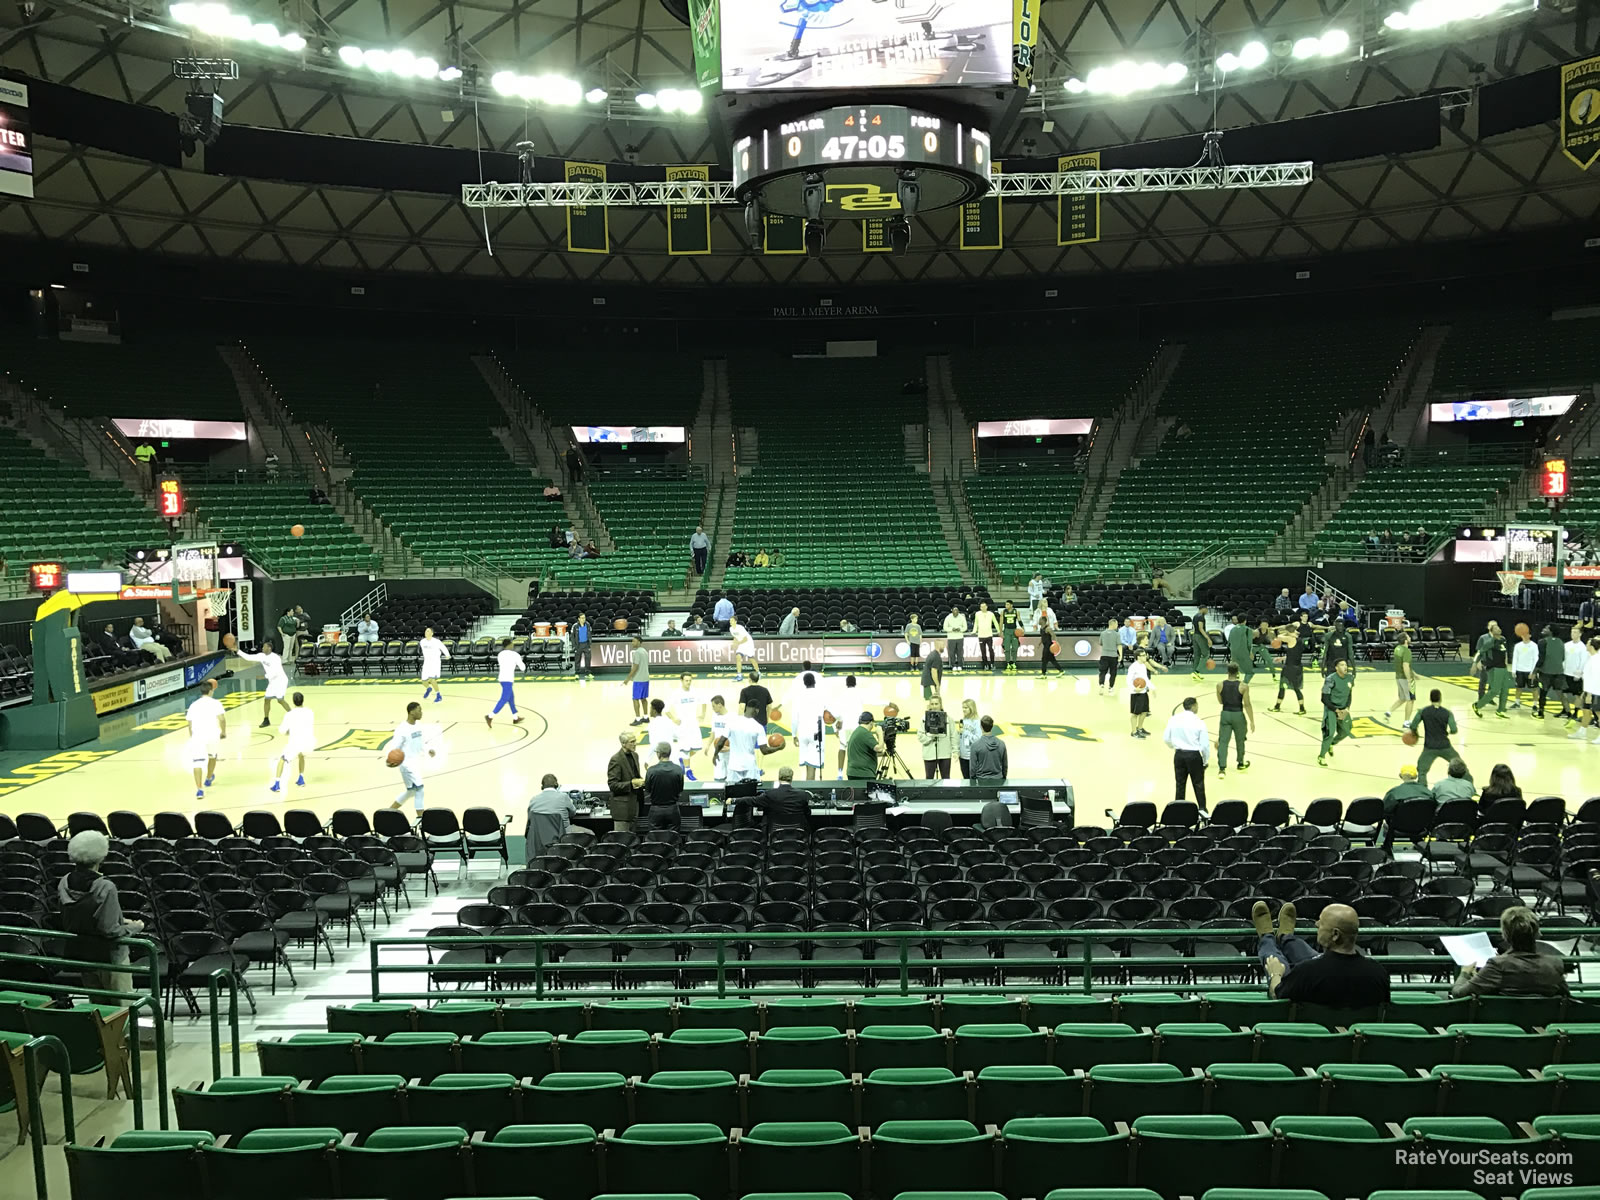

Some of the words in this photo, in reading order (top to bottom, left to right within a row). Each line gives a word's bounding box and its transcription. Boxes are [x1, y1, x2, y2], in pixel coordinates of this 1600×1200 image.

[780, 118, 825, 136] BAYLOR
[844, 115, 855, 127] 4
[871, 114, 882, 126] 4
[788, 136, 802, 157] 0
[821, 135, 906, 160] 47:05
[924, 131, 938, 153] 0
[567, 166, 604, 179] BAYLOR
[1061, 157, 1097, 172] BAYLOR
[668, 169, 706, 181] BAYLOR
[773, 307, 798, 316] PAUL
[809, 306, 842, 316] MEYER
[845, 306, 879, 315] ARENA
[241, 585, 249, 631] BEARS
[600, 644, 671, 664] Welcme
[676, 645, 692, 663] to
[697, 643, 722, 662] the
